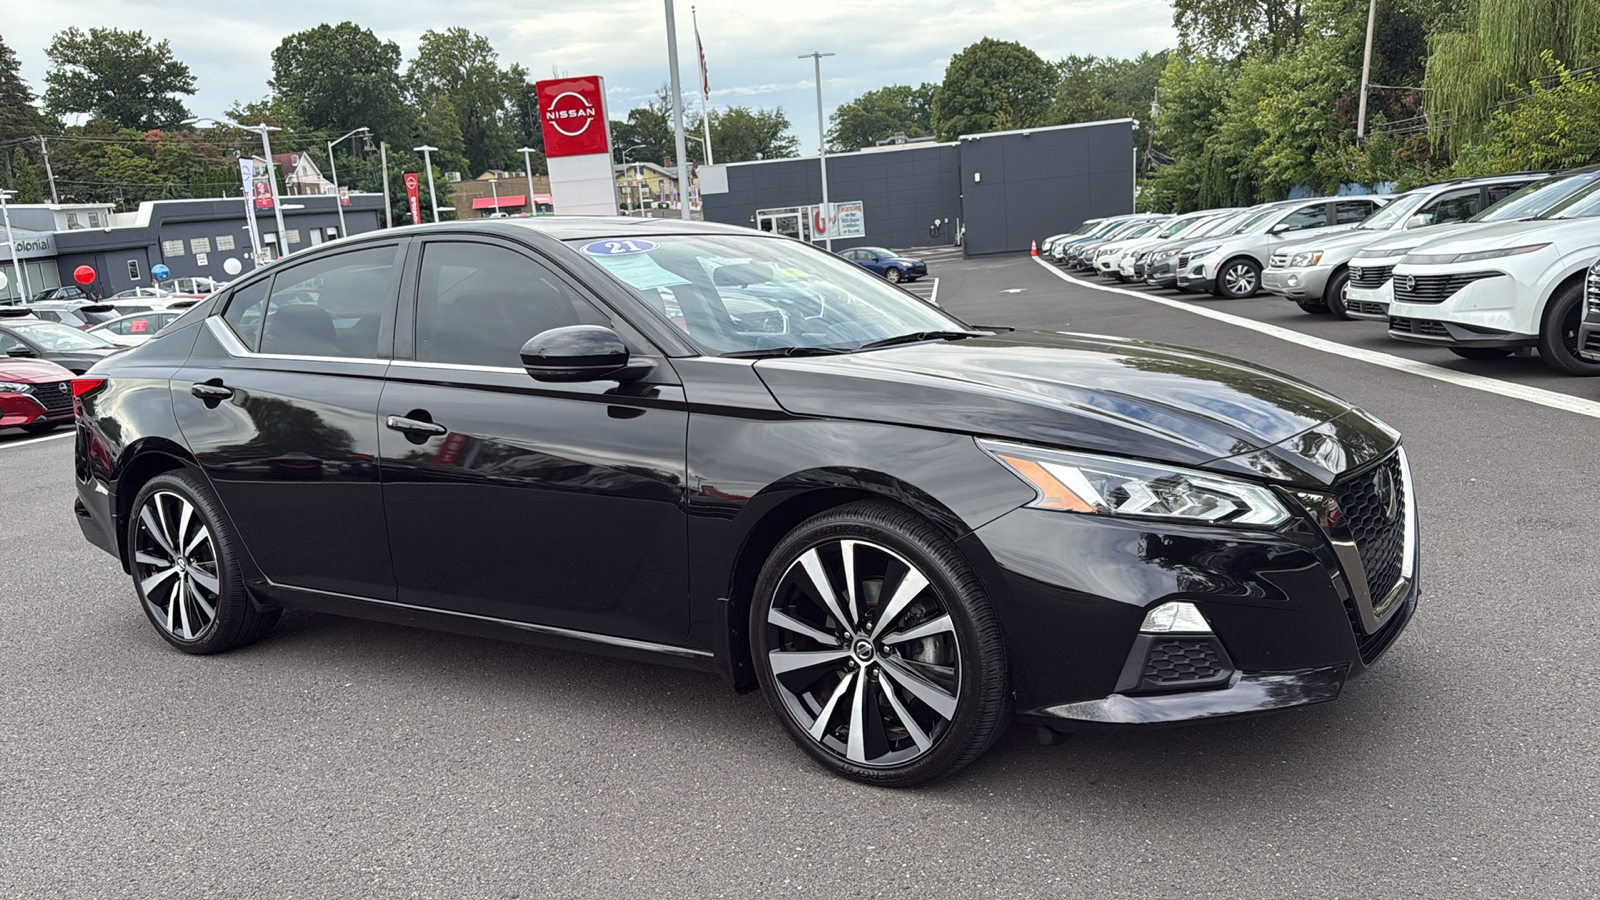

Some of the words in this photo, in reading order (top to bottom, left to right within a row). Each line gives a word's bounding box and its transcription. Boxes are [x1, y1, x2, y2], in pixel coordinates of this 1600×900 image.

[546, 108, 595, 119] NISSAN
[13, 239, 49, 252] olonial
[605, 240, 641, 254] 21
